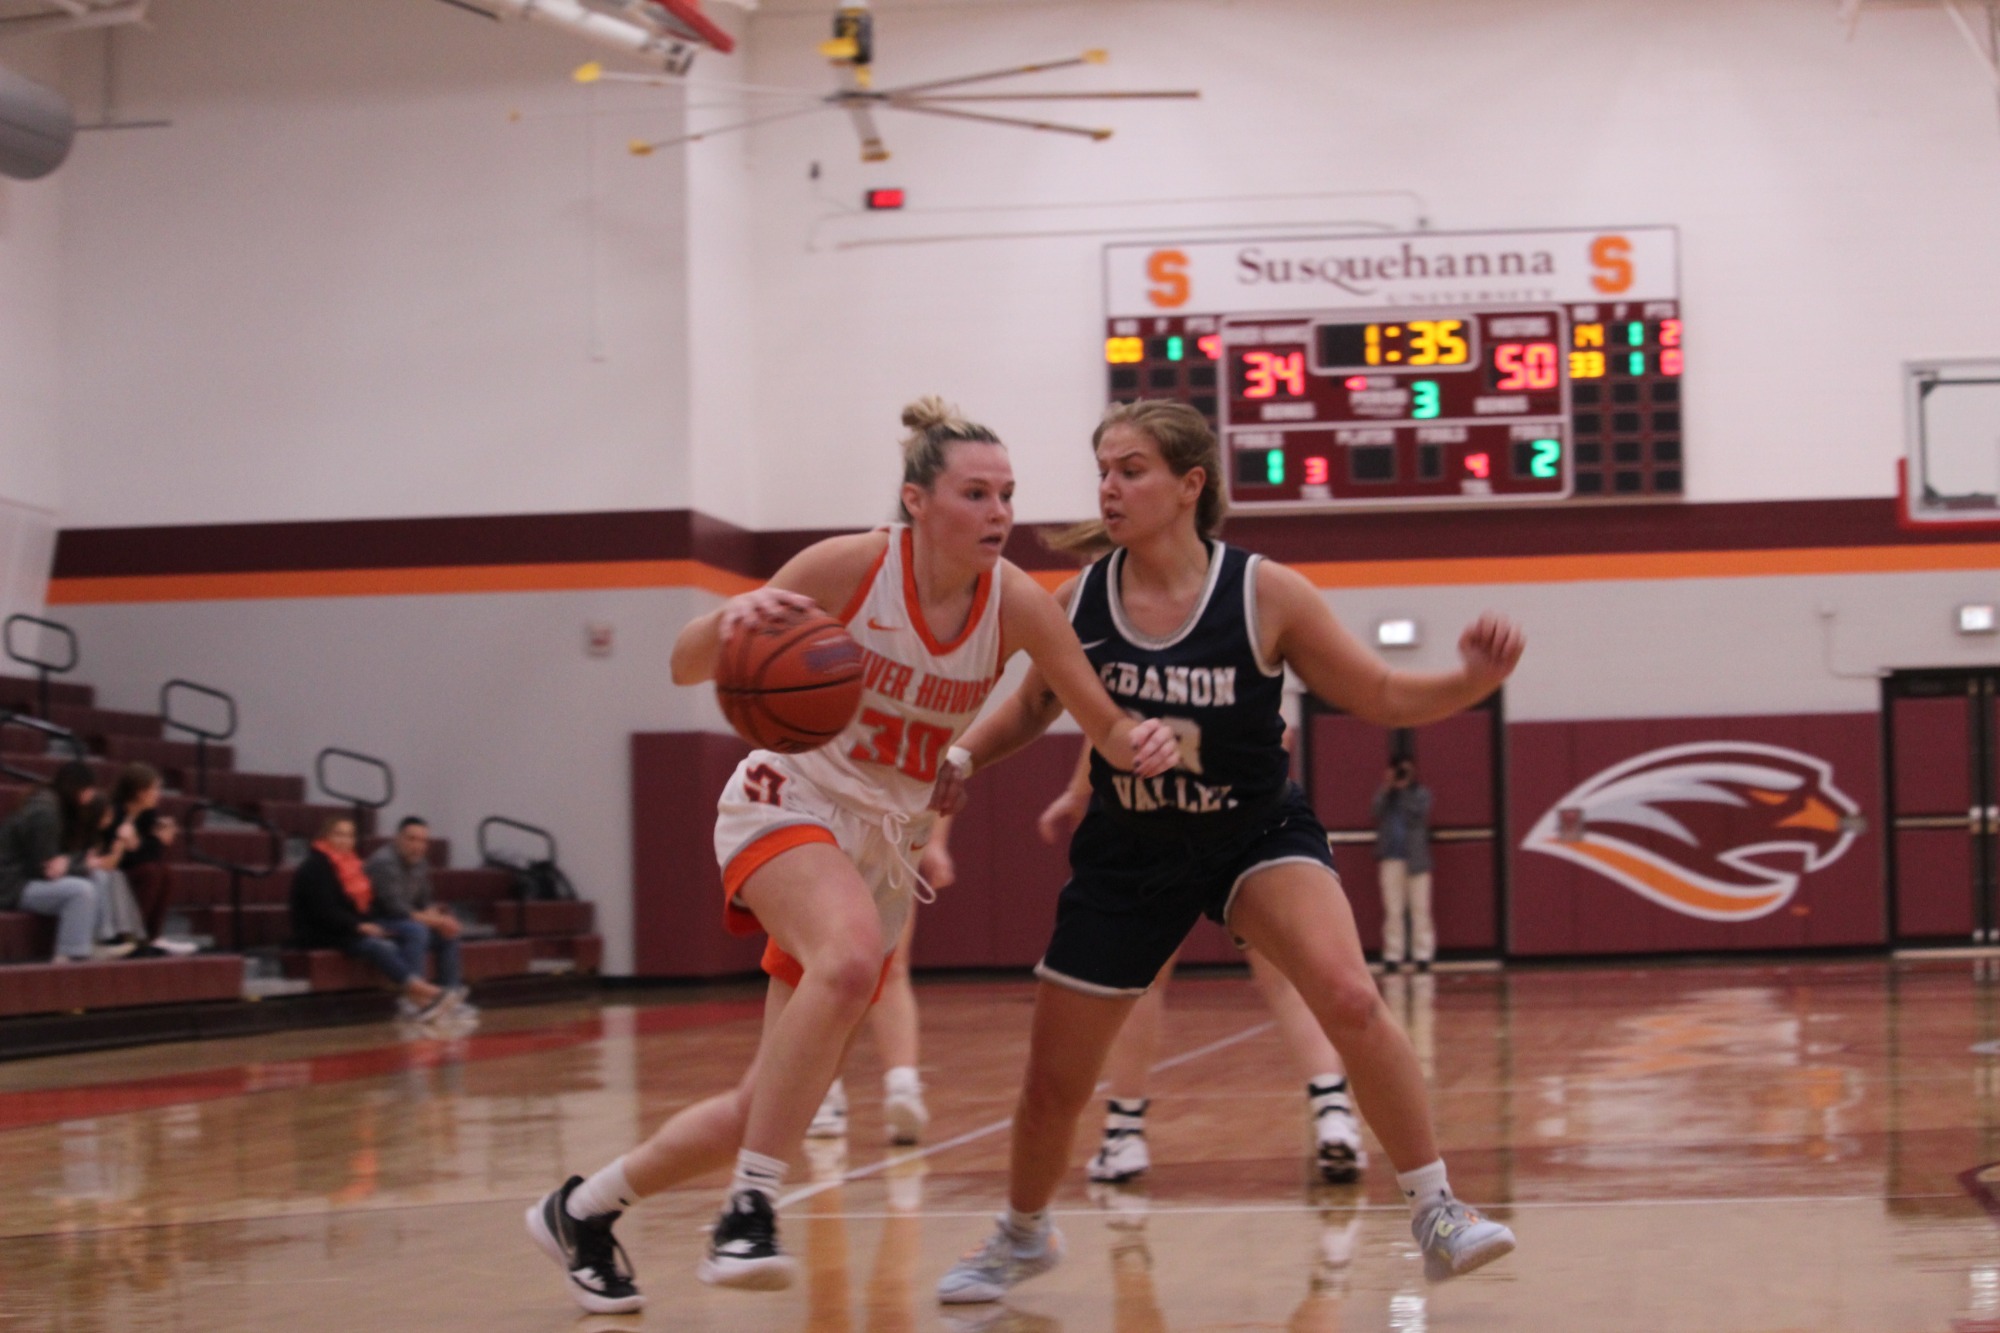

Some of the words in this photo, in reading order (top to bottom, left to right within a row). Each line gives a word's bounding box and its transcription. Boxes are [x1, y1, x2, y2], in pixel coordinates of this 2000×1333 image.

[1147, 249, 1190, 308] S
[1237, 243, 1556, 296] Susquehanna
[1590, 234, 1633, 293] S
[1167, 335, 1183, 361] 1
[1364, 319, 1468, 366] 1:35
[1628, 321, 1644, 347] 1
[1659, 319, 1683, 347] 2
[1242, 351, 1305, 398] 34
[1494, 343, 1558, 390] 50
[1568, 351, 1606, 378] 33
[1629, 351, 1645, 376] 1
[1411, 380, 1440, 419] 3
[1267, 448, 1284, 485] 1
[1304, 456, 1329, 485] 3
[1530, 439, 1561, 478] 2
[1100, 661, 1236, 707] EBANON
[851, 705, 954, 783] 30
